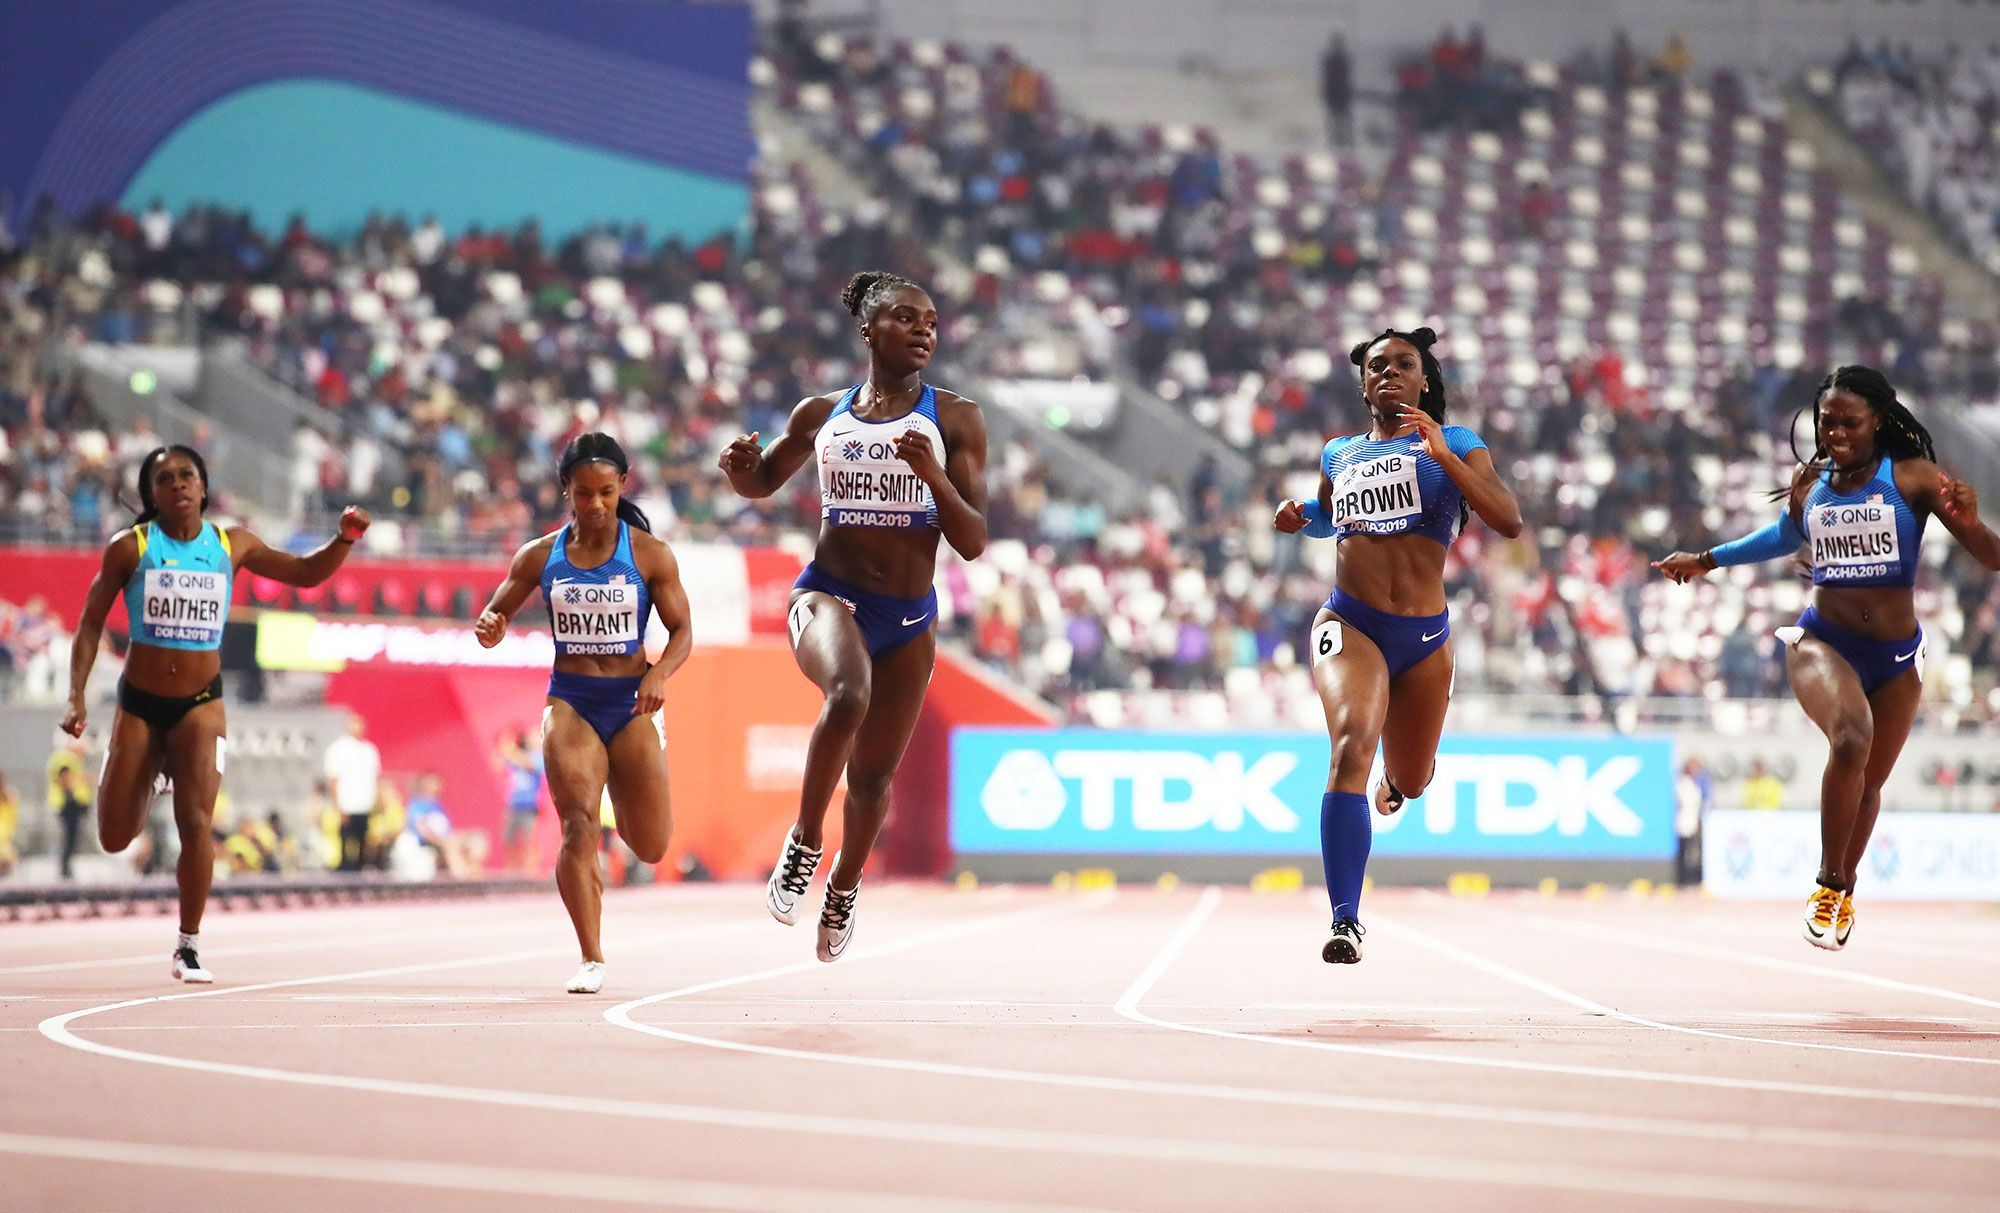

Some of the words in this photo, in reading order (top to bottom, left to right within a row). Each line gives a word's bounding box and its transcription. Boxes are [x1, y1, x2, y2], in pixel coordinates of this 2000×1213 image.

[868, 443, 898, 460] QN
[1362, 457, 1402, 477] QNB
[829, 471, 924, 502] ASHER-SMITH
[1336, 481, 1414, 523] BROWN
[838, 511, 912, 527] DOHA2019
[1841, 508, 1882, 524] QNB
[1815, 531, 1893, 562] ANNELUS
[178, 573, 215, 590] QNB
[1825, 564, 1887, 578] DOHA2019
[585, 588, 625, 603] QNB
[148, 596, 219, 623] GAITHER
[557, 611, 632, 636] BRYANT
[566, 642, 627, 655] DOHA2019
[1319, 630, 1333, 655] 6
[1052, 749, 1299, 832] TDK
[1424, 754, 1645, 837] TDK
